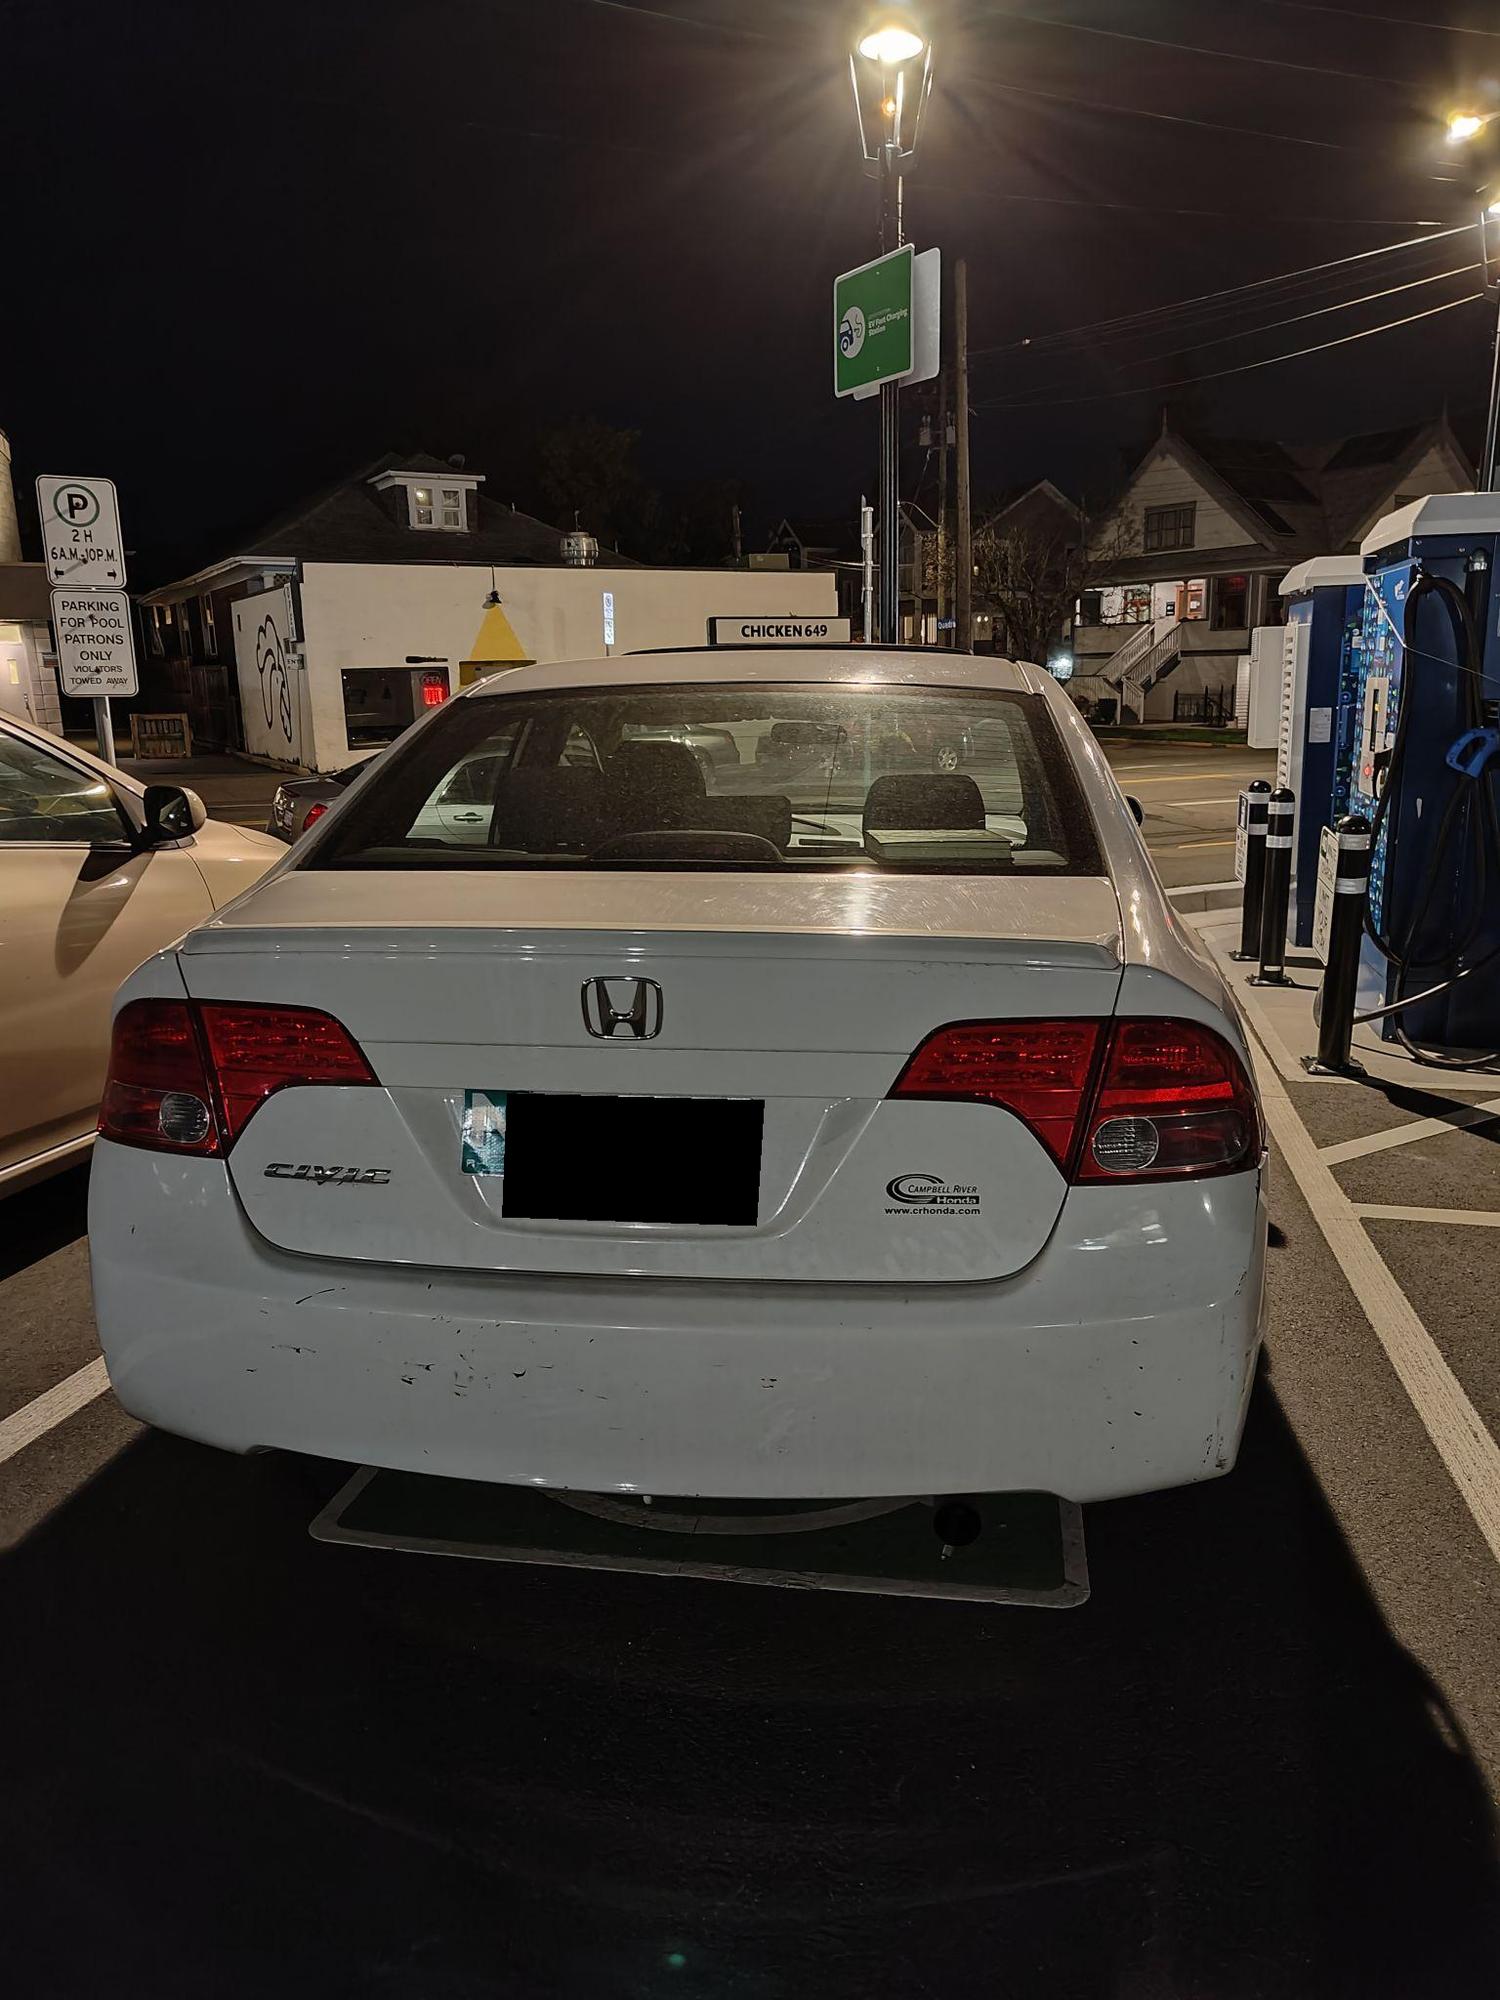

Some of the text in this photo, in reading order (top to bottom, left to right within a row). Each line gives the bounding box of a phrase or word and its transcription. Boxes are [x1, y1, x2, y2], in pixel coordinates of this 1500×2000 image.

[67, 493, 88, 519] P
[71, 528, 93, 543] 2 H
[61, 600, 119, 612] PARKING
[60, 617, 125, 629] FOR POOL
[741, 624, 828, 638] CHICKEN 649
[64, 633, 124, 645] PATRONS
[80, 650, 112, 661] ONLY
[73, 665, 123, 673] VIOLATORS
[69, 677, 128, 685] TOWED AWAY
[263, 1163, 391, 1186] CIVIC
[908, 1184, 978, 1194] CAMPBELL RIVER
[936, 1196, 977, 1205] Honda
[884, 1206, 980, 1215] www.crhonda.com
